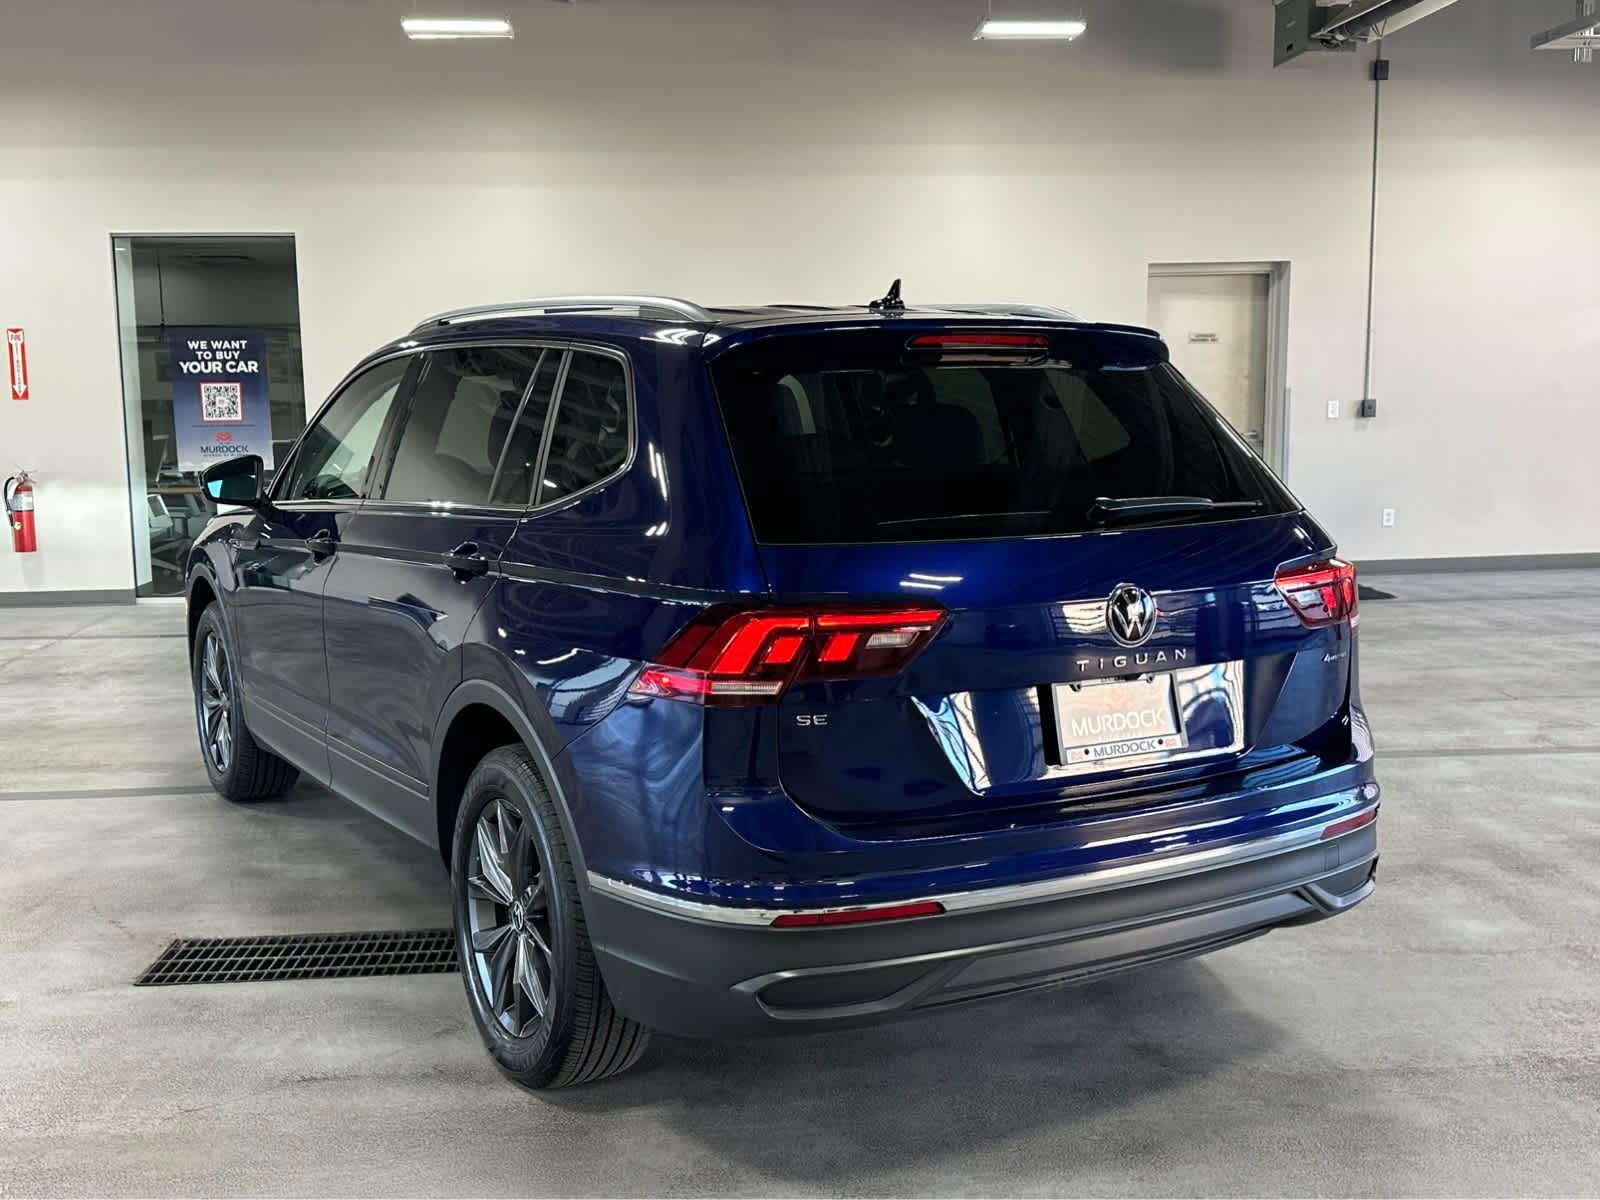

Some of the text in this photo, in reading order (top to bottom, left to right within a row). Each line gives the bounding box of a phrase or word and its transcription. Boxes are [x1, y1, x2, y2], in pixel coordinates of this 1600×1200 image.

[187, 340, 247, 350] WE WANT
[195, 351, 240, 360] TO BUY
[179, 361, 259, 374] YOUR CAR
[200, 445, 249, 454] MURDOCK
[1076, 648, 1187, 672] TIGUAN
[796, 714, 828, 726] SE
[1071, 708, 1166, 736] MURDOCK
[1094, 740, 1156, 758] MURDOCK
